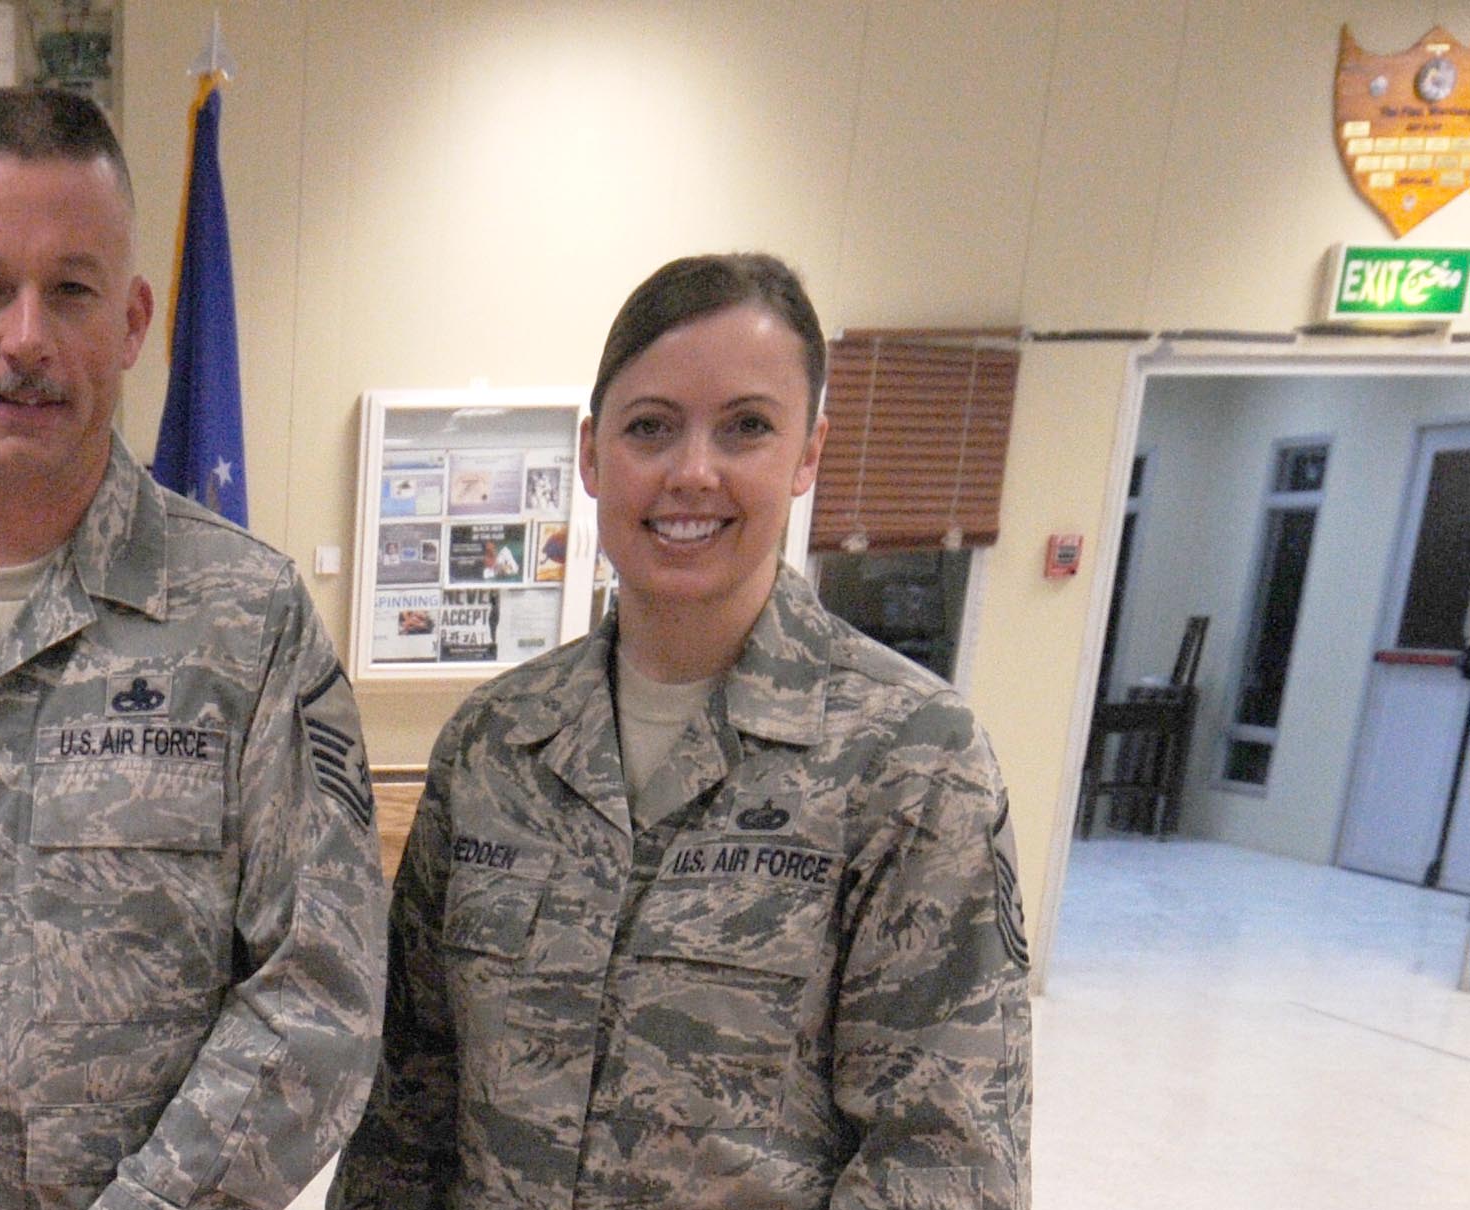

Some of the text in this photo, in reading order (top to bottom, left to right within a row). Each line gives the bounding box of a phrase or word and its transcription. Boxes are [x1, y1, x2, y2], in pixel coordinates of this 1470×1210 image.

[1341, 260, 1404, 307] EXIT
[441, 608, 488, 626] ACCEPT
[60, 727, 207, 758] U.S. AIR FORCE
[672, 847, 833, 884] U.S. AIR FORCE
